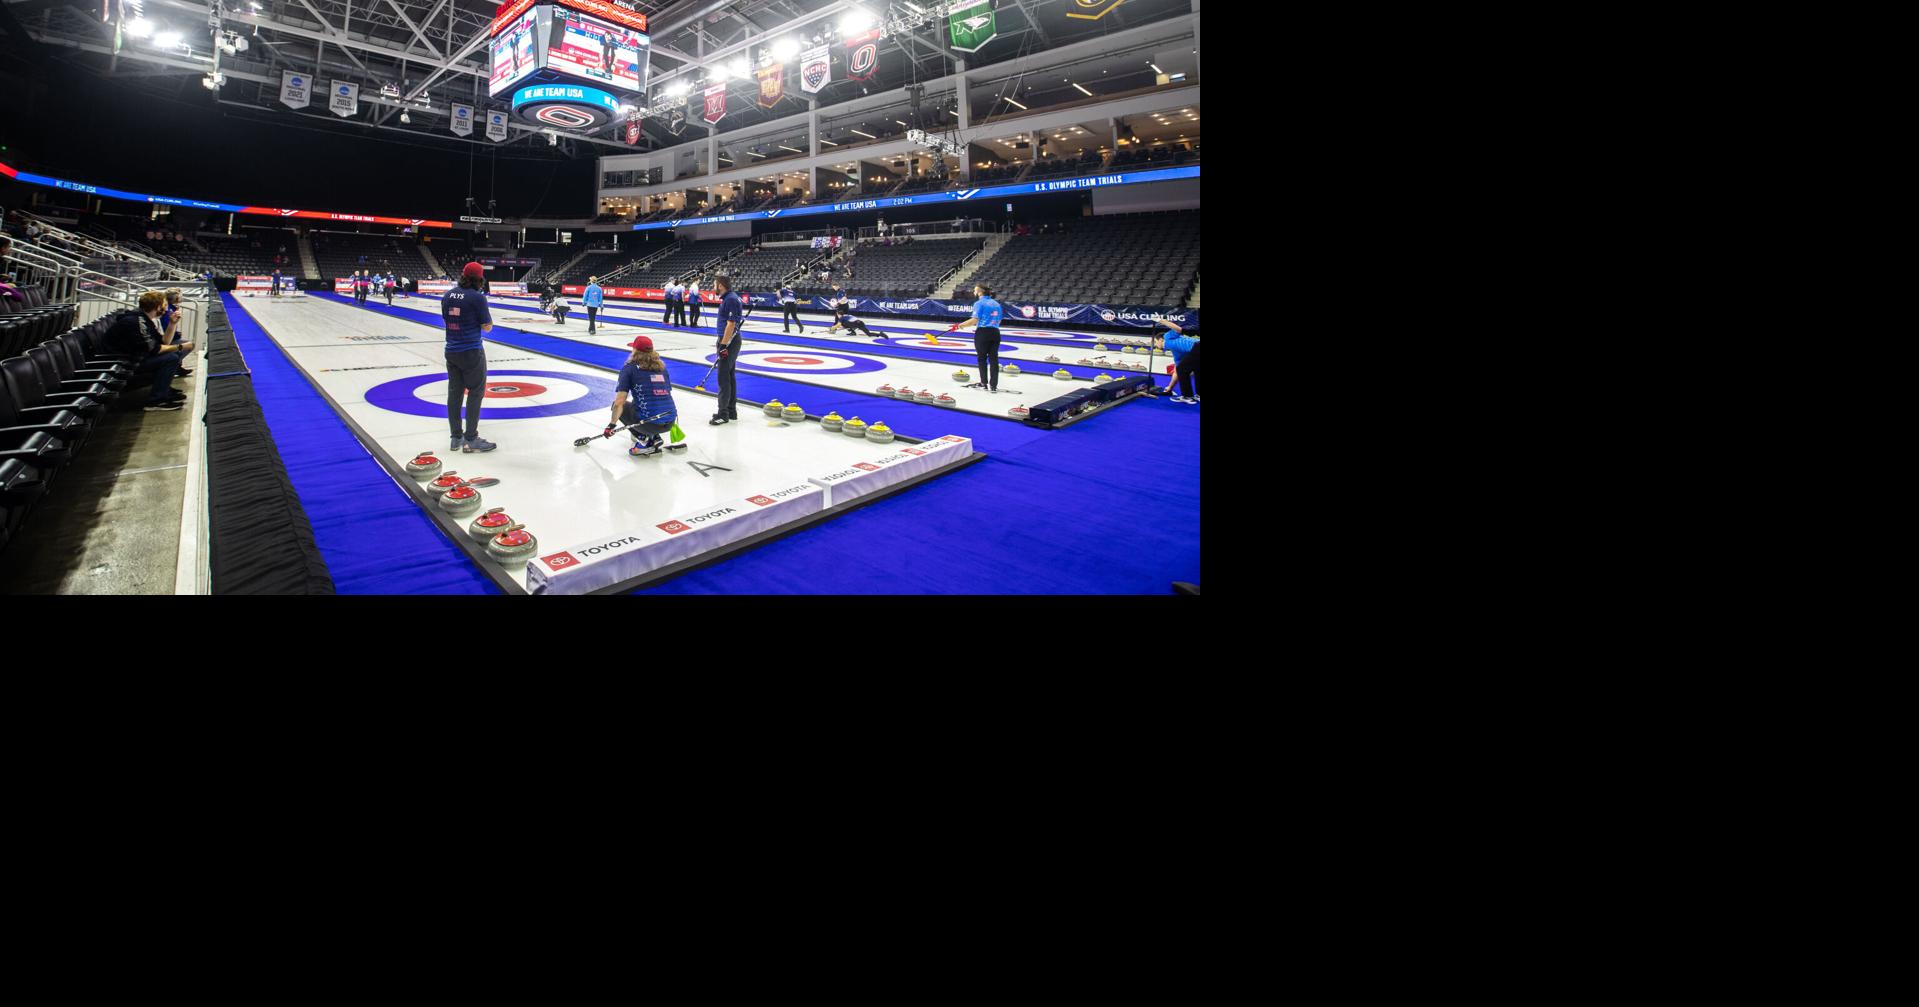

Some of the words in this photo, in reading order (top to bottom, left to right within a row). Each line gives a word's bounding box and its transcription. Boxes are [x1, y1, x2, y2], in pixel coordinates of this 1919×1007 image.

[613, 0, 635, 12] ARENA
[804, 63, 827, 77] NCHC
[525, 90, 532, 99] WE
[533, 89, 544, 97] ARE
[545, 88, 566, 96] TEAM
[567, 88, 584, 98] USA
[336, 98, 351, 106] 2015
[1035, 183, 1047, 191] U.S.
[1049, 180, 1077, 190] OLYMPIC
[1078, 178, 1096, 187] TEAM
[1098, 175, 1122, 185] TRIALS
[850, 201, 864, 209] TEAM
[865, 200, 877, 208] USA
[449, 292, 465, 300] PLYS
[1117, 312, 1138, 320] USA
[1139, 313, 1186, 322] CULING
[686, 461, 732, 477] A
[770, 484, 812, 499] TOYOTA
[686, 507, 736, 525] TOYOTA
[577, 536, 640, 558] TOYOTA
